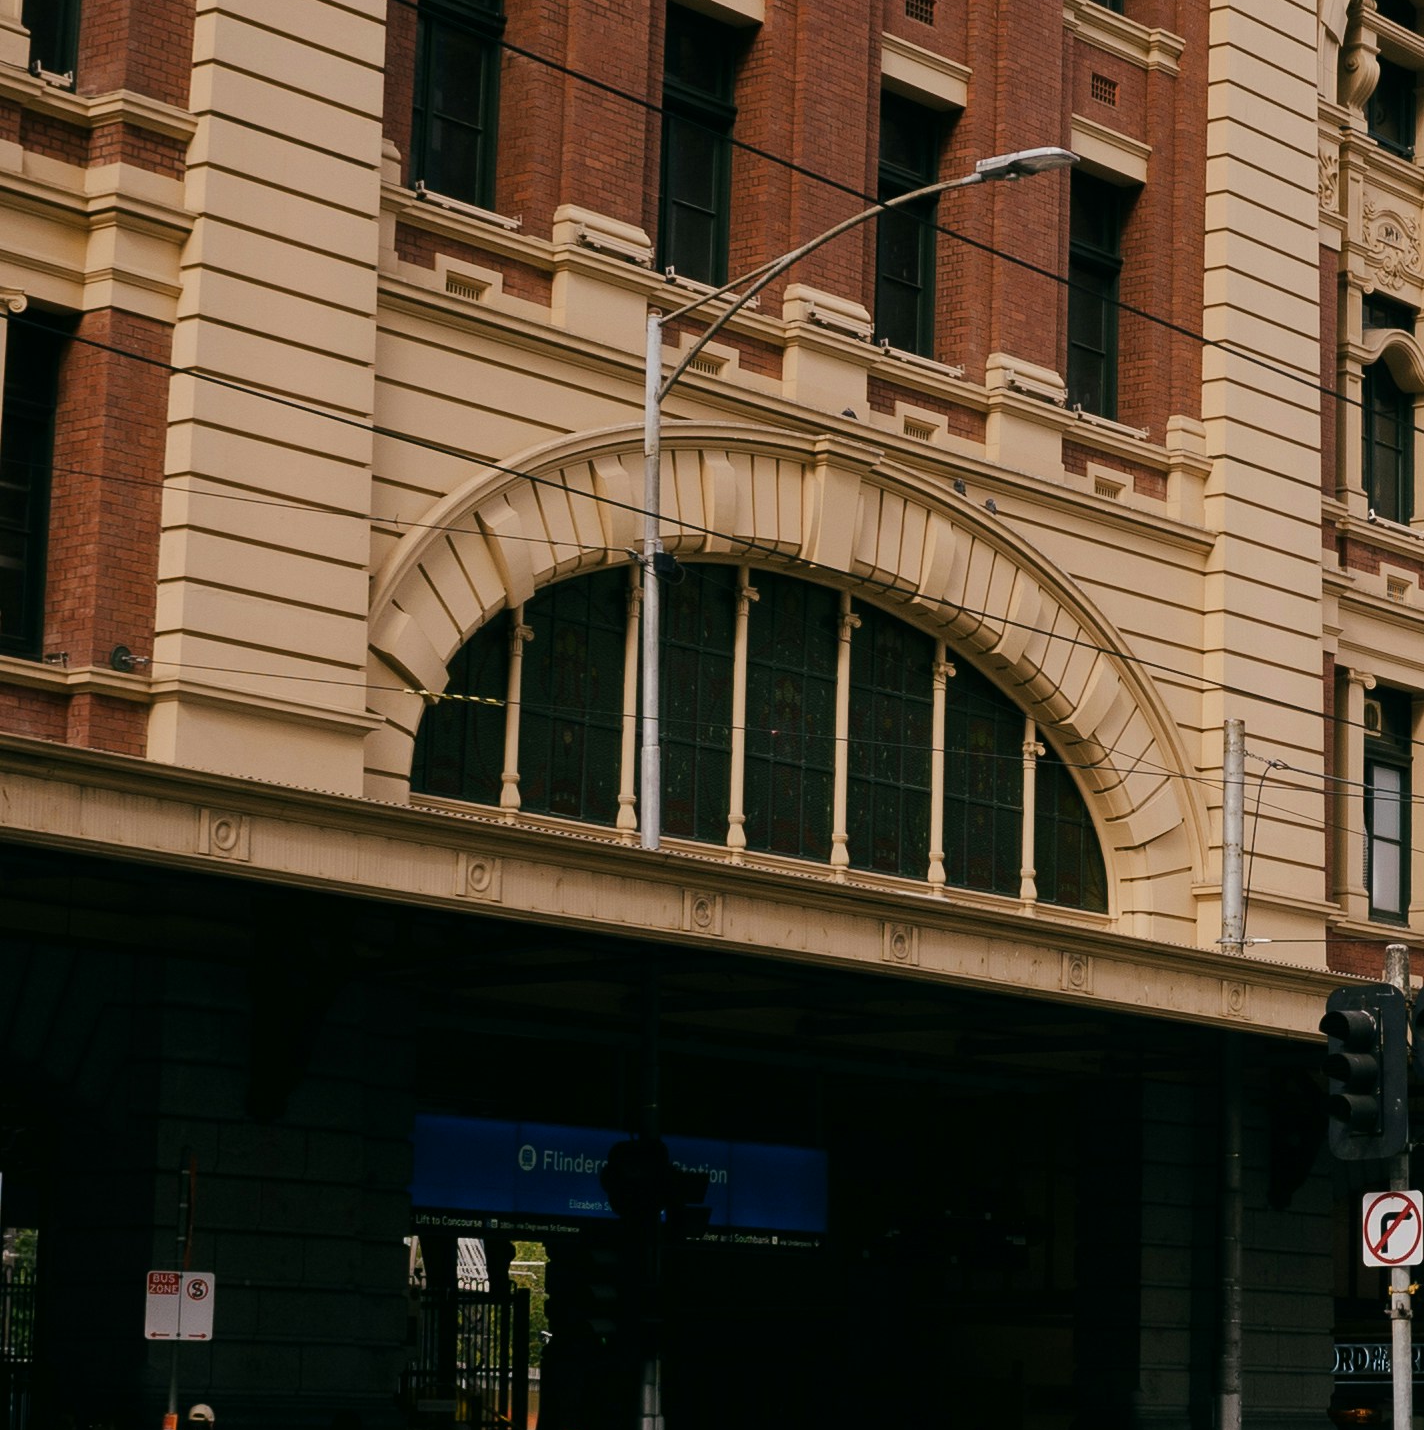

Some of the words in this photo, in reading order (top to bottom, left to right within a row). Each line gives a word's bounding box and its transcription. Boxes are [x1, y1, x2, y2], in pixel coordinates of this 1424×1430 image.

[569, 1198, 602, 1211] Elizabeth
[415, 1213, 430, 1225] Lift
[431, 1215, 441, 1226] to
[442, 1215, 483, 1228] Concourse
[152, 1274, 175, 1283] BUS
[149, 1284, 178, 1294] ZONE
